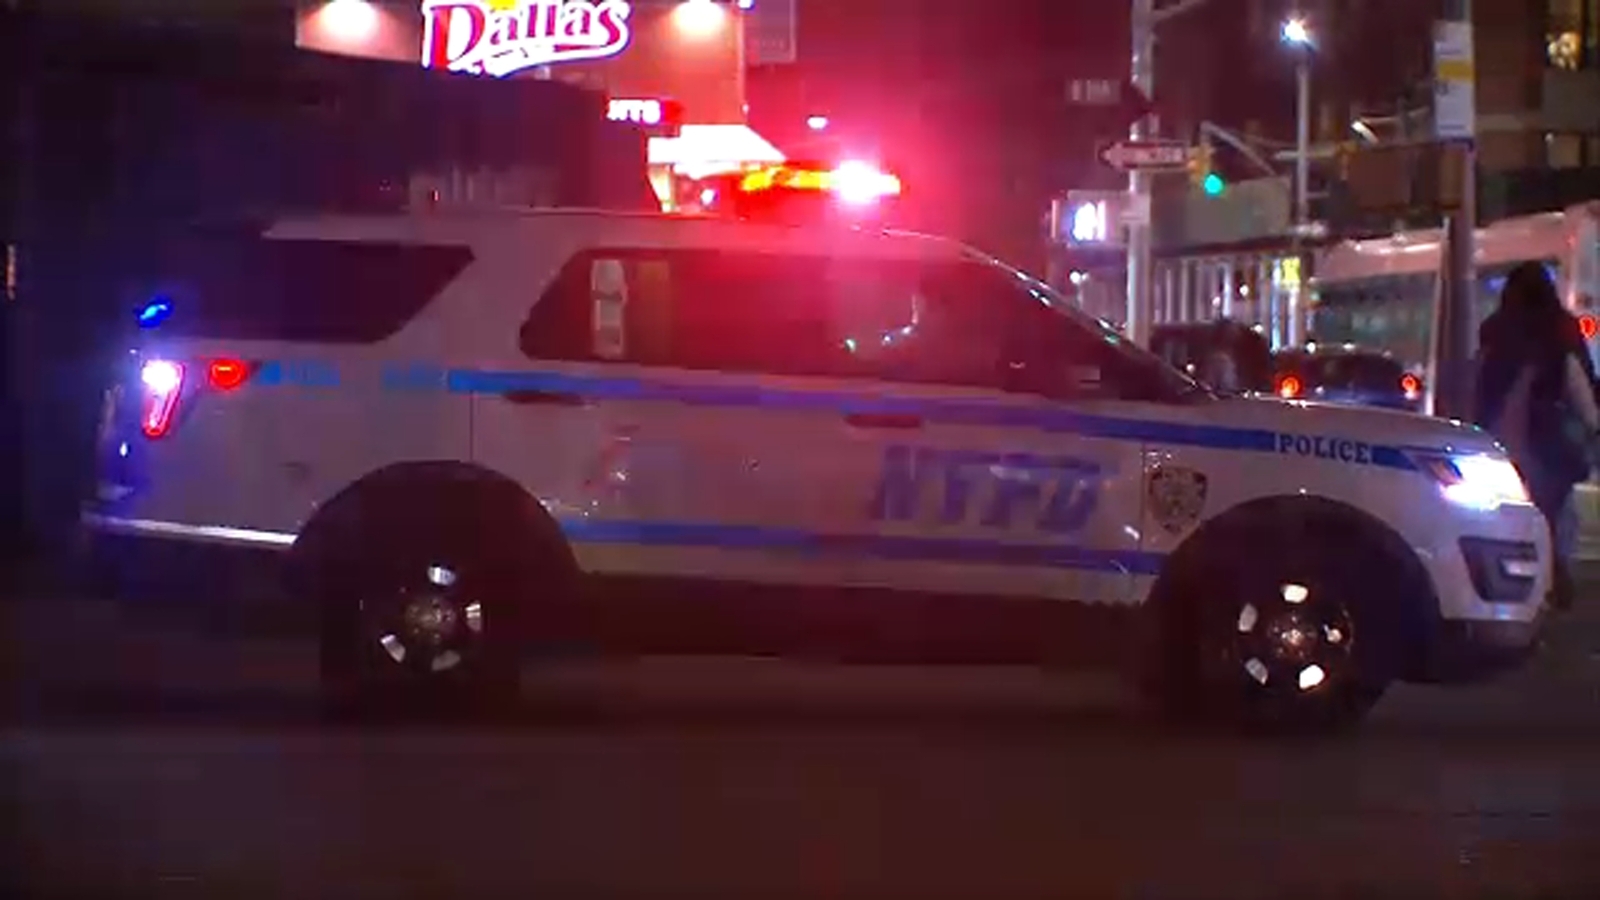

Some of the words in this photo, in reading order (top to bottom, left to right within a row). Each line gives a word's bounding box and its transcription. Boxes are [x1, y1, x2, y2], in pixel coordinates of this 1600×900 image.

[423, 0, 630, 75] Dallas
[1278, 432, 1370, 465] POLICE
[868, 444, 1102, 533] NYPD
